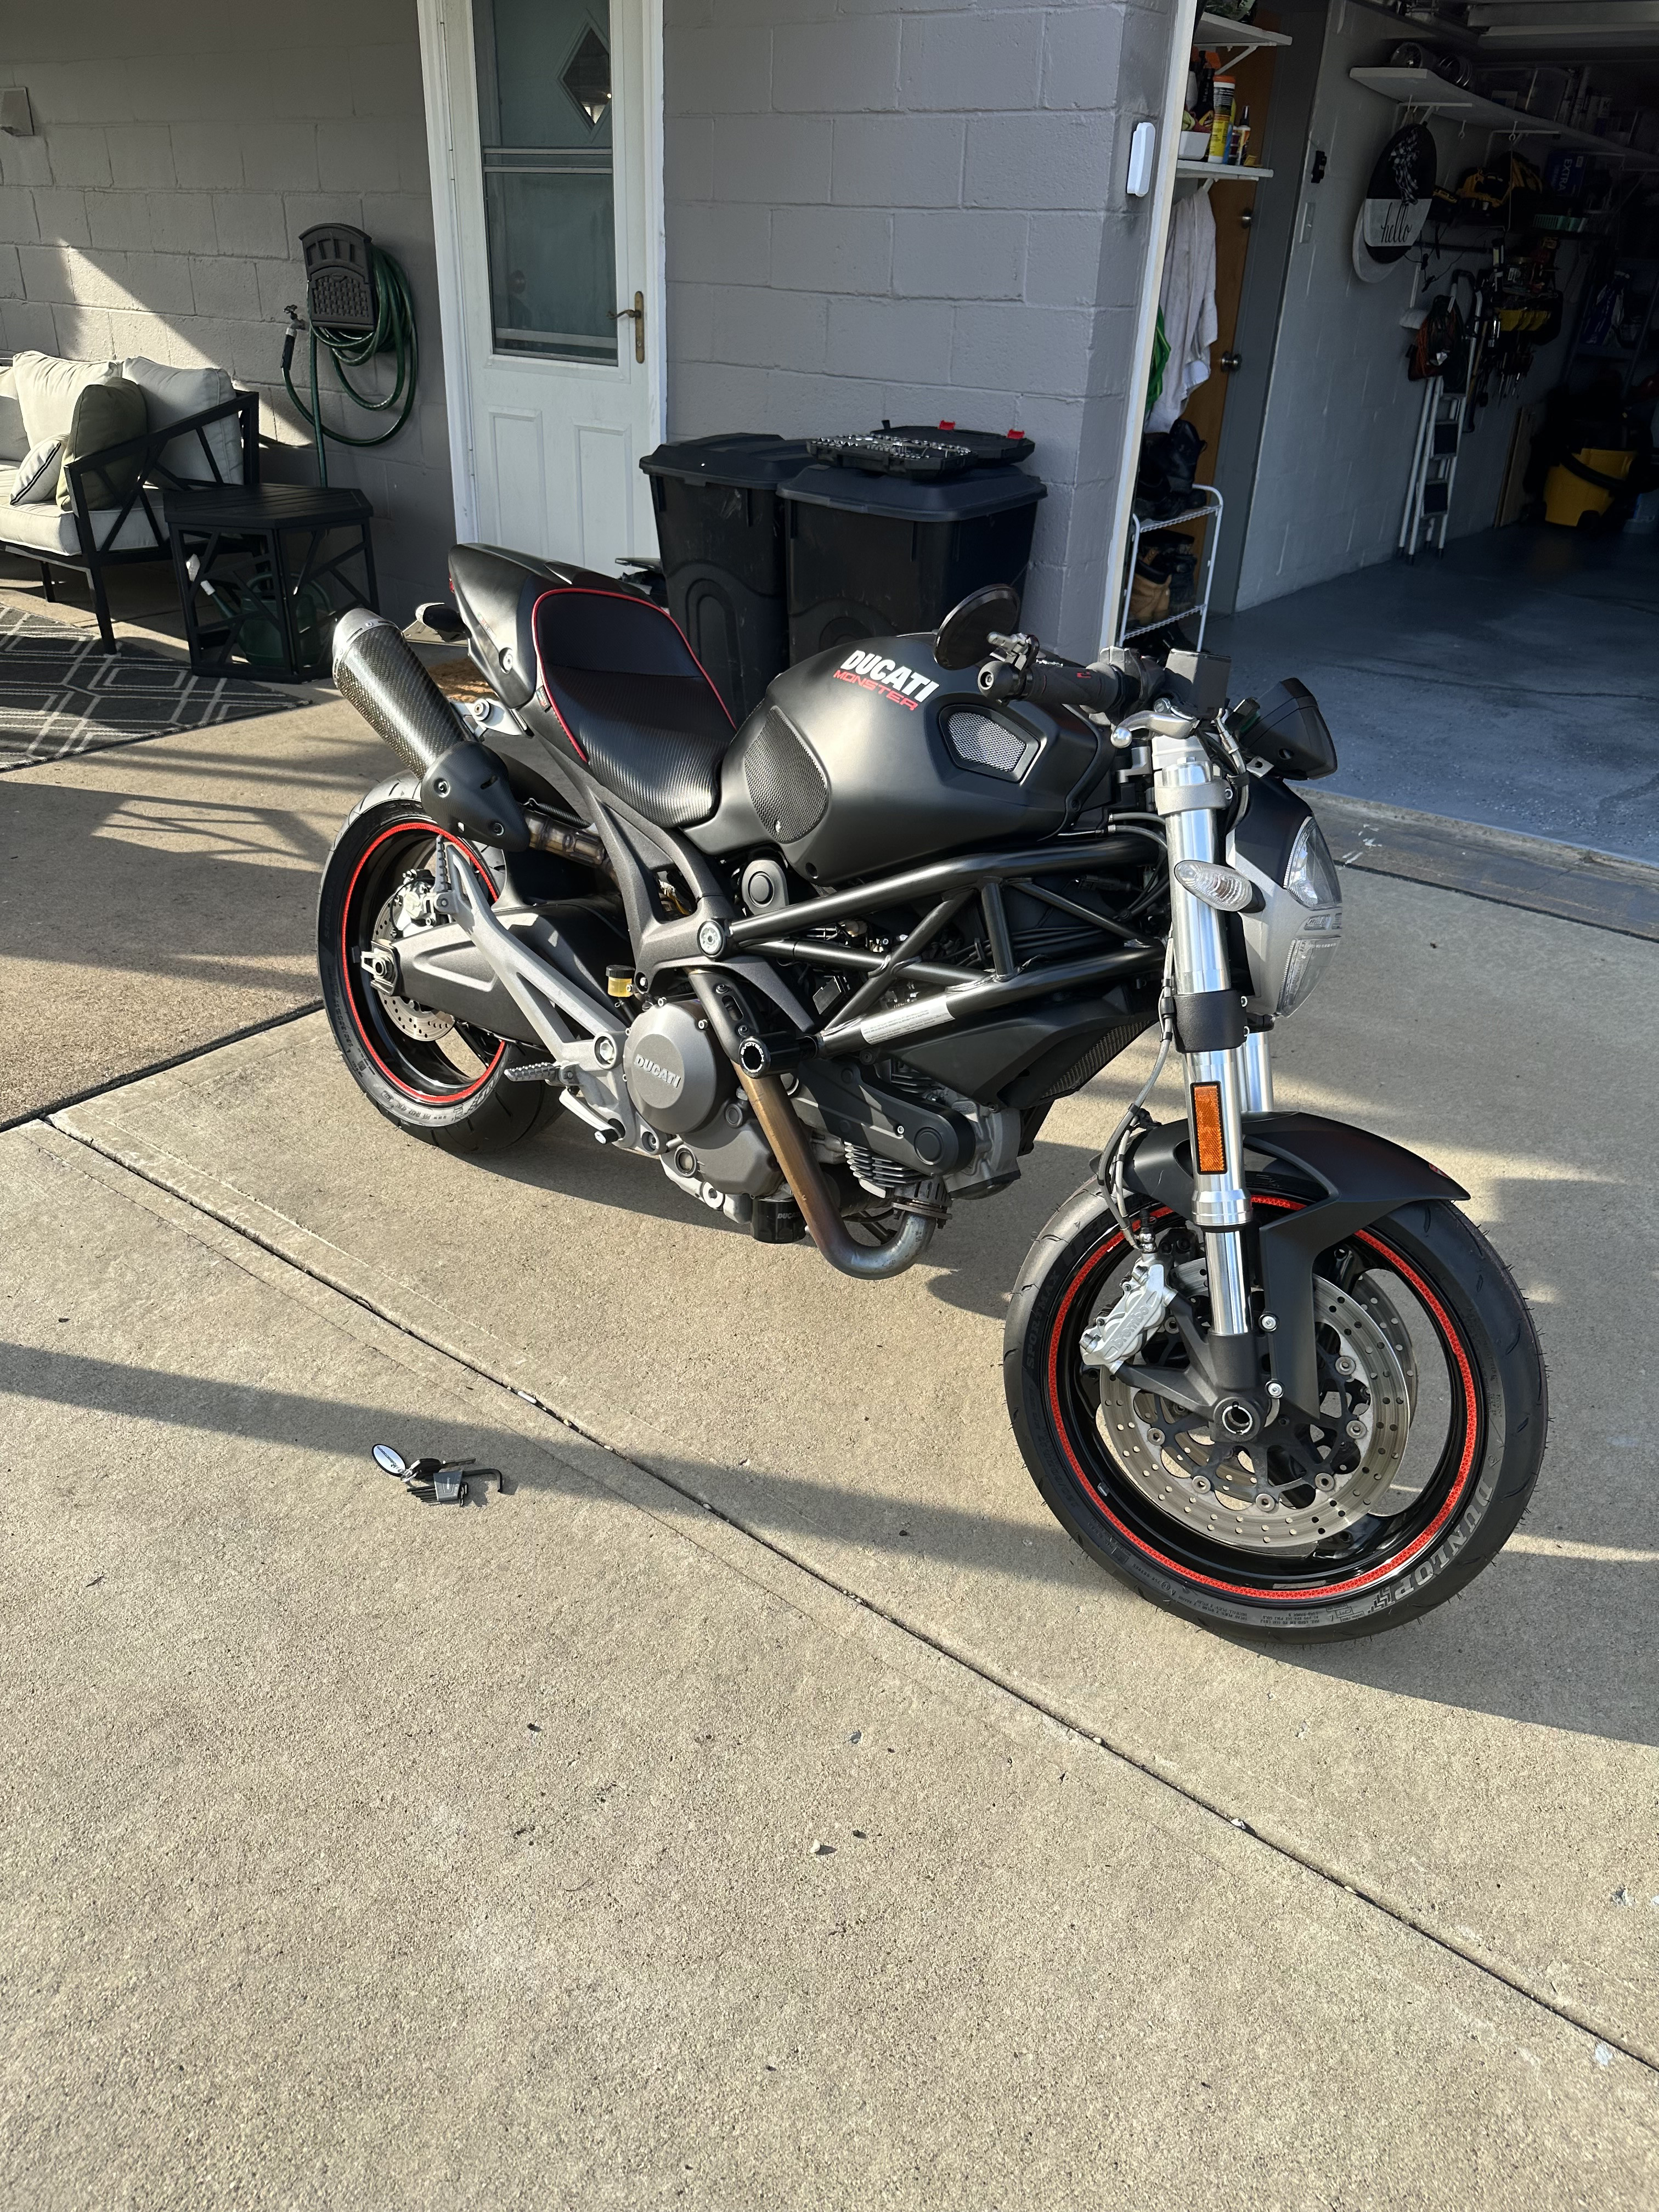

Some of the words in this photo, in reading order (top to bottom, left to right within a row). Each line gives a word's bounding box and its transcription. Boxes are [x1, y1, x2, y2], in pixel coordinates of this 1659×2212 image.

[1556, 157, 1573, 192] EXTRA
[1381, 202, 1412, 243] hello
[833, 669, 919, 711] MONSTER
[840, 650, 940, 703] DUCATI
[634, 1054, 681, 1088] DUCATI
[1026, 1269, 1061, 1368] SPORTMAX
[1110, 1305, 1149, 1348] brembo
[1394, 1480, 1493, 1600] DUNLOP
